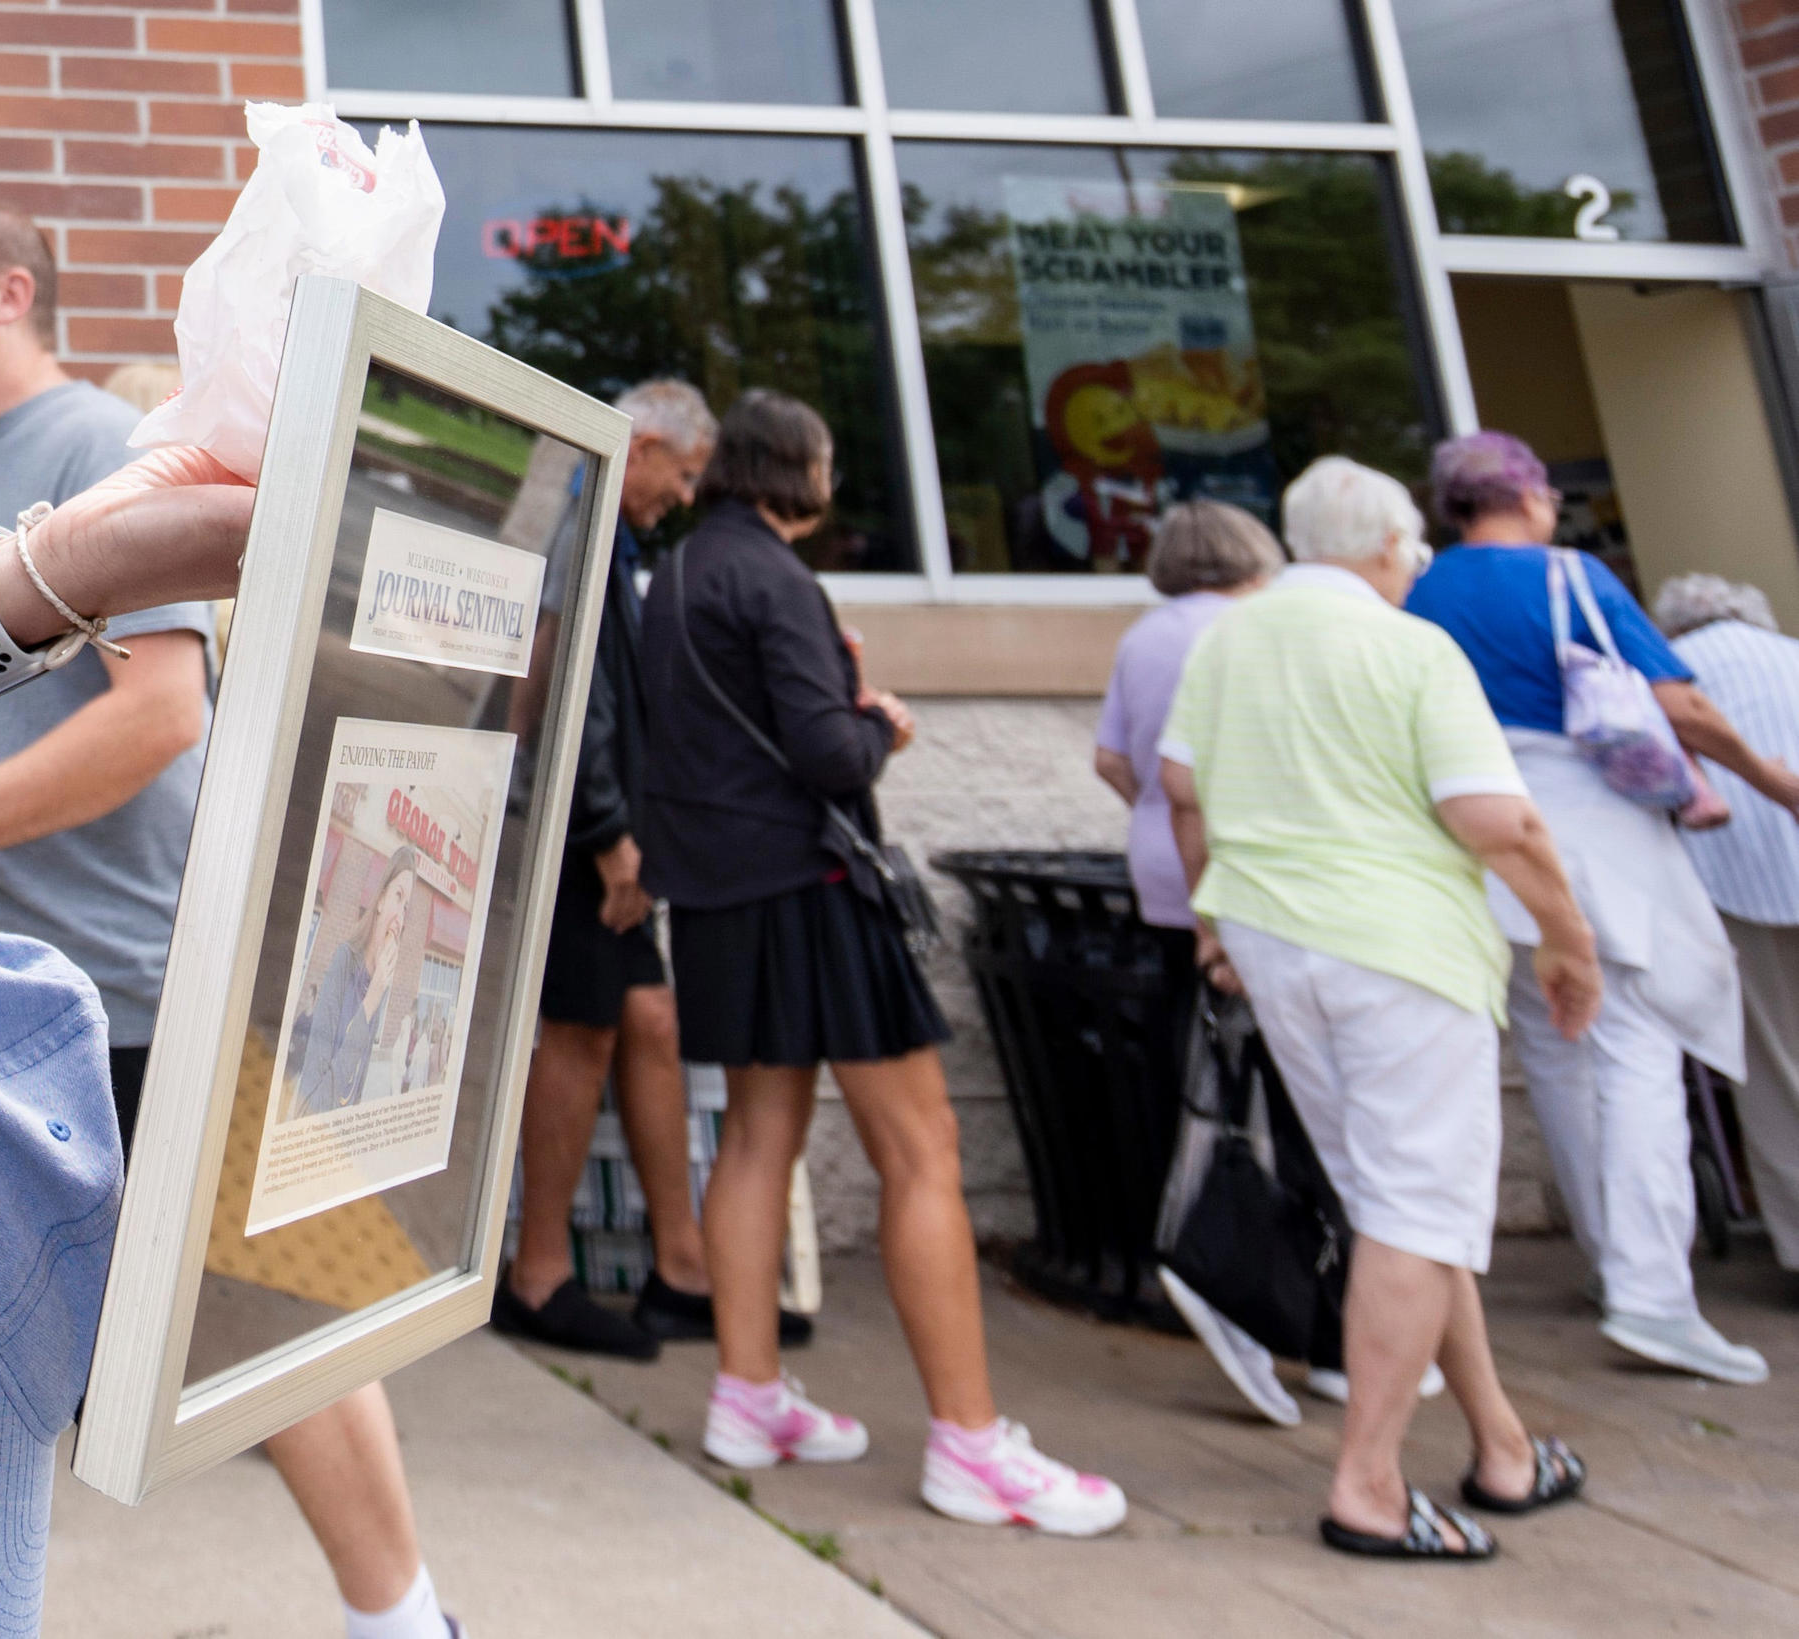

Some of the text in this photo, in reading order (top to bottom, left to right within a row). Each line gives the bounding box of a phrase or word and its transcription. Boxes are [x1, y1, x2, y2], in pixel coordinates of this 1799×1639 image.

[1564, 174, 1619, 241] 2
[481, 216, 630, 259] OPEN
[1125, 226, 1227, 259] YOUR
[406, 551, 457, 578] MILWAUKEE
[368, 569, 526, 640] JOURNAL SENTINEL
[340, 744, 439, 771] ENJOYING THE PAYOFF
